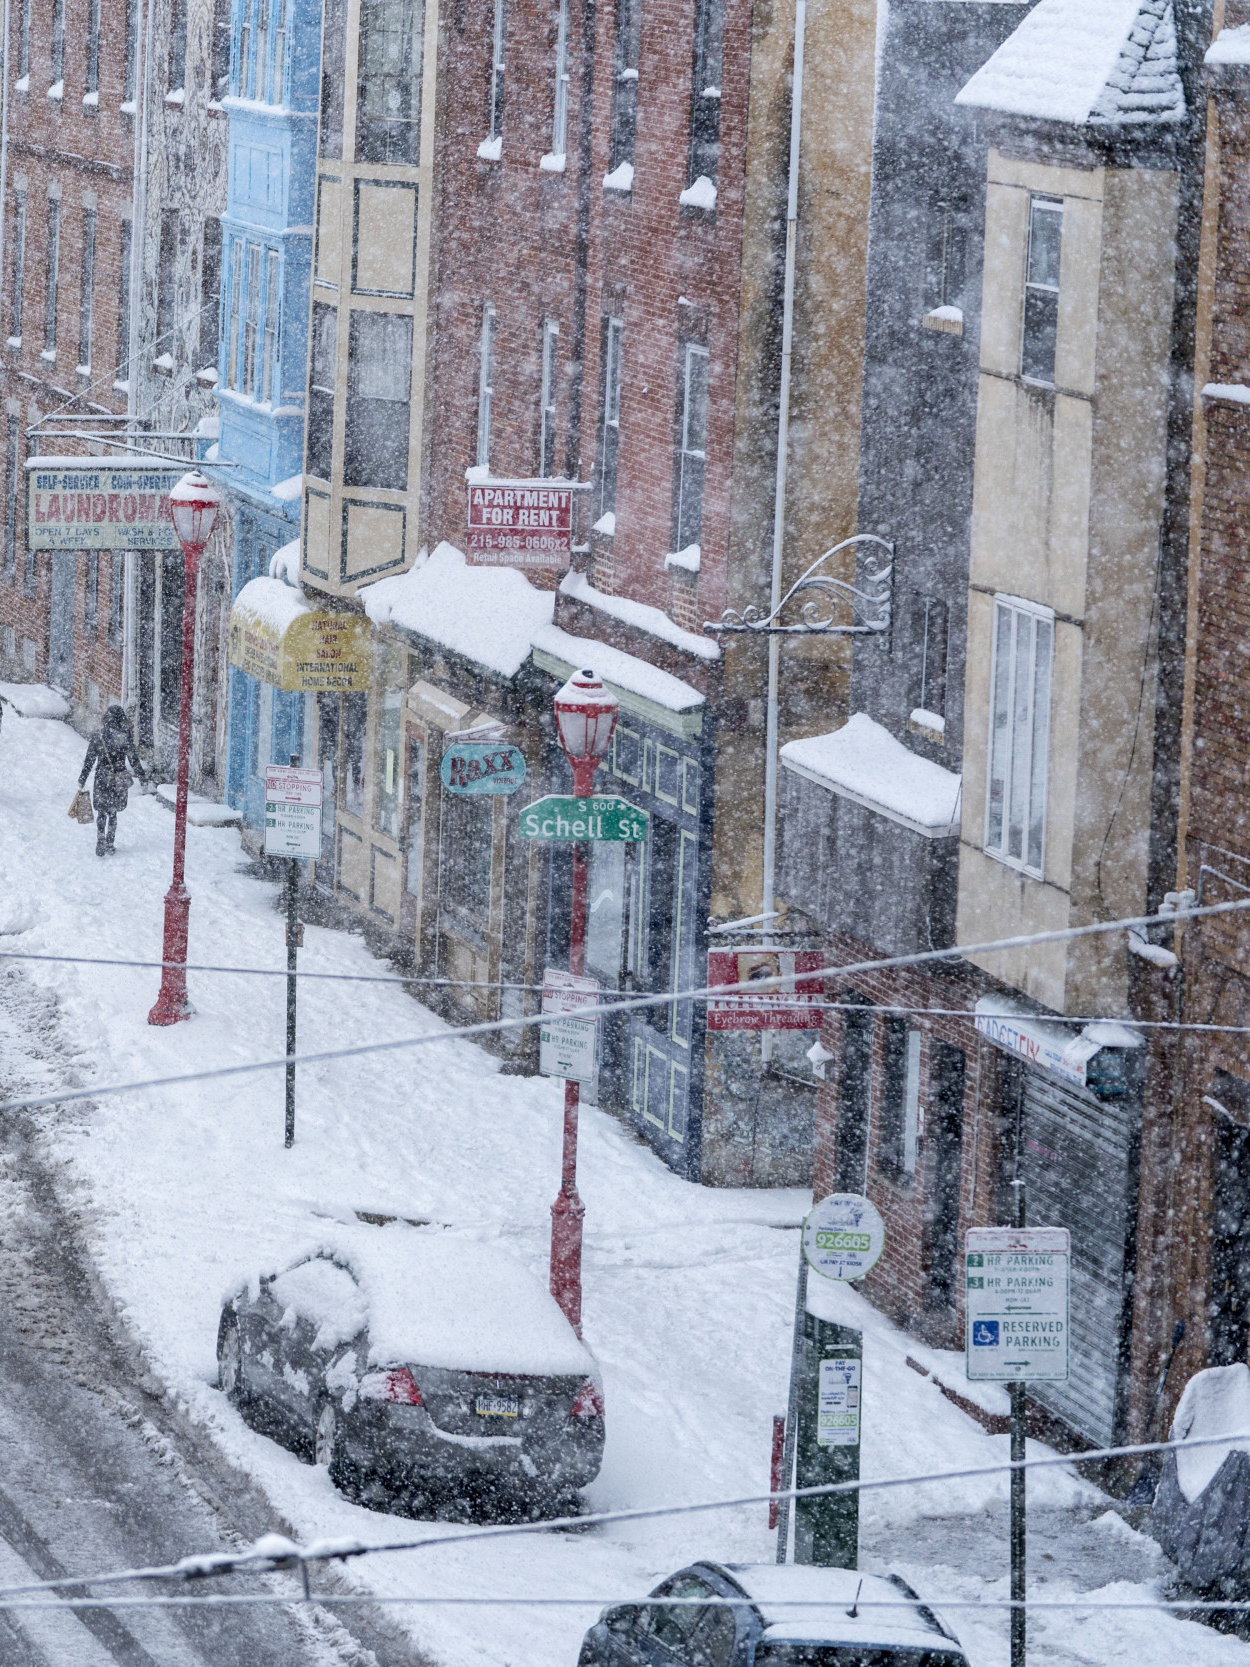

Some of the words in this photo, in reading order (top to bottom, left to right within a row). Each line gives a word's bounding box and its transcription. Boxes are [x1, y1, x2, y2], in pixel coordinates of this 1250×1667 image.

[473, 489, 569, 508] APARTMENT
[35, 493, 172, 523] LAUNDROMA
[482, 508, 513, 525] FOR
[518, 509, 560, 527] RENT
[35, 527, 62, 536] OPEN
[75, 527, 100, 536] DAYS
[118, 528, 144, 537] WASH
[470, 534, 568, 551] 215-985-0606x2
[473, 552, 497, 562] Retail
[499, 553, 524, 564] Space
[525, 554, 562, 564] Available
[311, 621, 348, 631] NATURAL
[319, 635, 338, 645] HAIR
[316, 649, 342, 659] SALON
[296, 662, 359, 673] INTERNATIONAL
[302, 677, 325, 687] HOME
[278, 782, 312, 792] STOPPING
[288, 806, 315, 815] PARKING
[578, 801, 587, 811] S
[592, 802, 614, 811] 600
[288, 821, 315, 830] PARKING
[525, 815, 602, 838] Schell
[618, 819, 639, 838] St
[554, 991, 588, 1005] STOPPING
[714, 1013, 759, 1027] Eyebrow
[763, 1012, 818, 1027] Threading
[817, 1233, 870, 1249] 926605
[987, 1256, 1001, 1266] HR
[1007, 1256, 1054, 1266] PARKING
[987, 1277, 1001, 1287] HR
[1007, 1277, 1054, 1288] PARKING
[1003, 1321, 1063, 1333] RESERVED
[1006, 1336, 1061, 1348] PARKING
[820, 1415, 857, 1426] 926605
